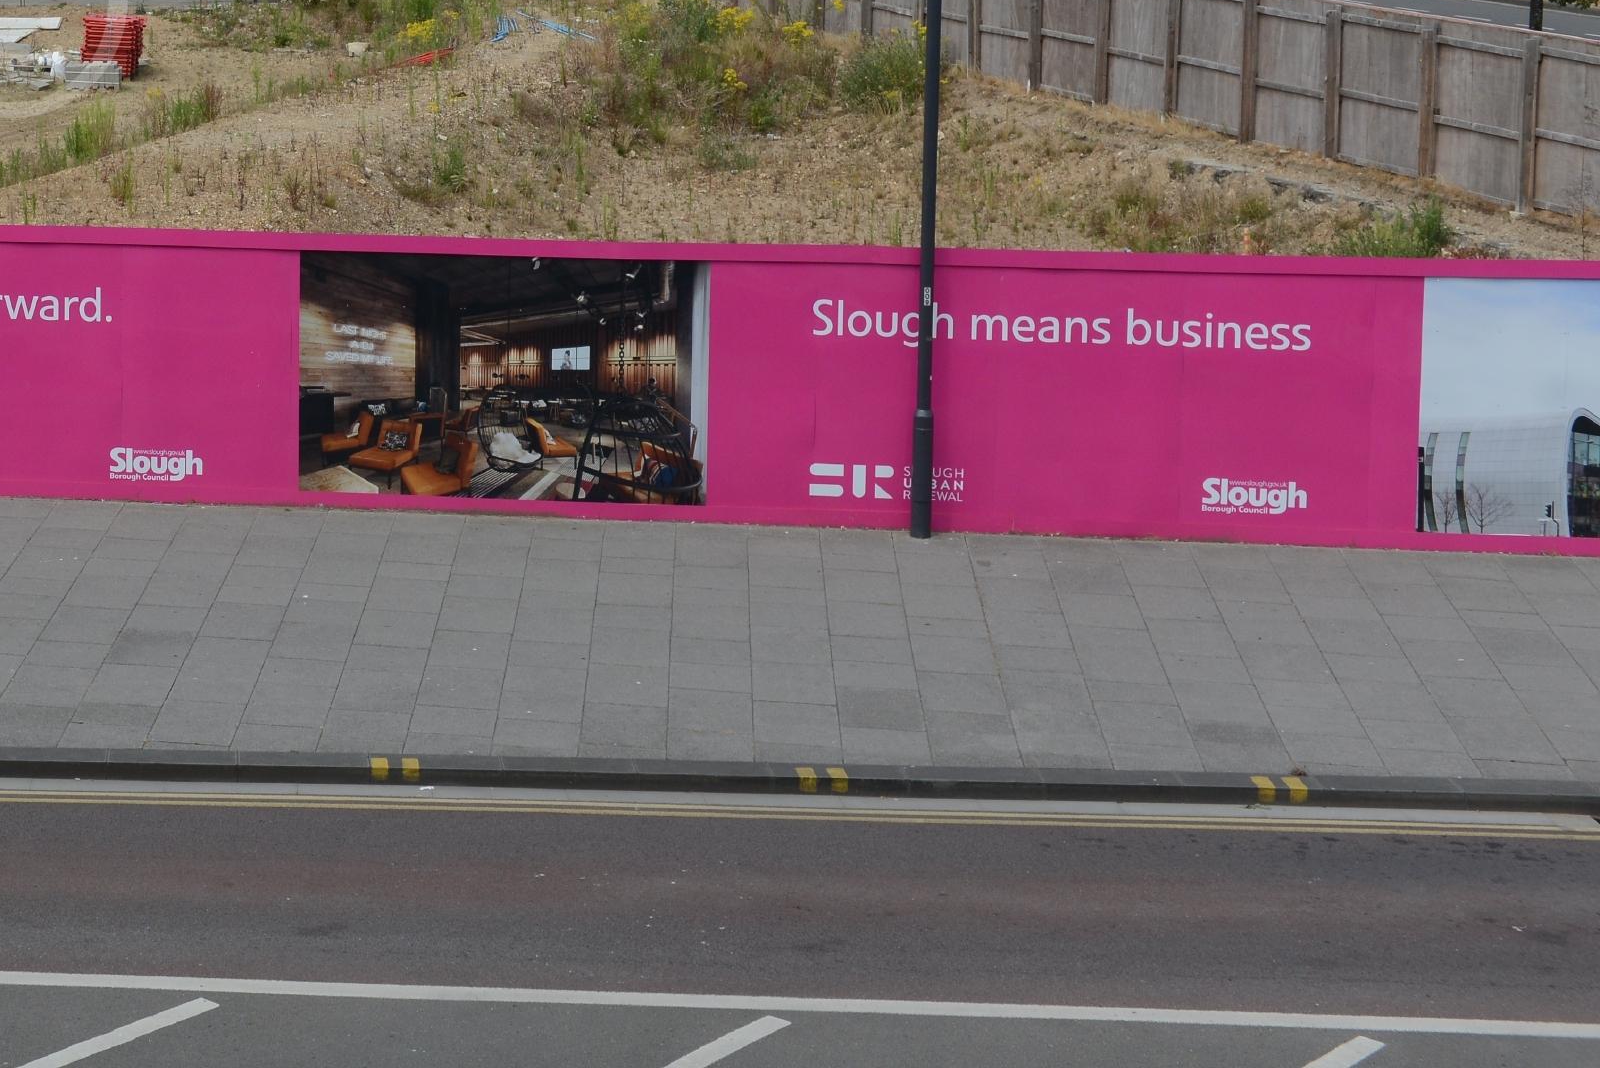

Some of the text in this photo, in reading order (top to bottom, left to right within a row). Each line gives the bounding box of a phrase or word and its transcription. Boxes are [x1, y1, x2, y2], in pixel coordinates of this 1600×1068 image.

[812, 298, 1312, 351] Slough means business
[109, 447, 203, 481] Slough
[903, 466, 965, 479] SUGH
[109, 473, 169, 481] Borough Council
[1201, 478, 1308, 515] Slough
[1201, 504, 1268, 514] Borough Council
